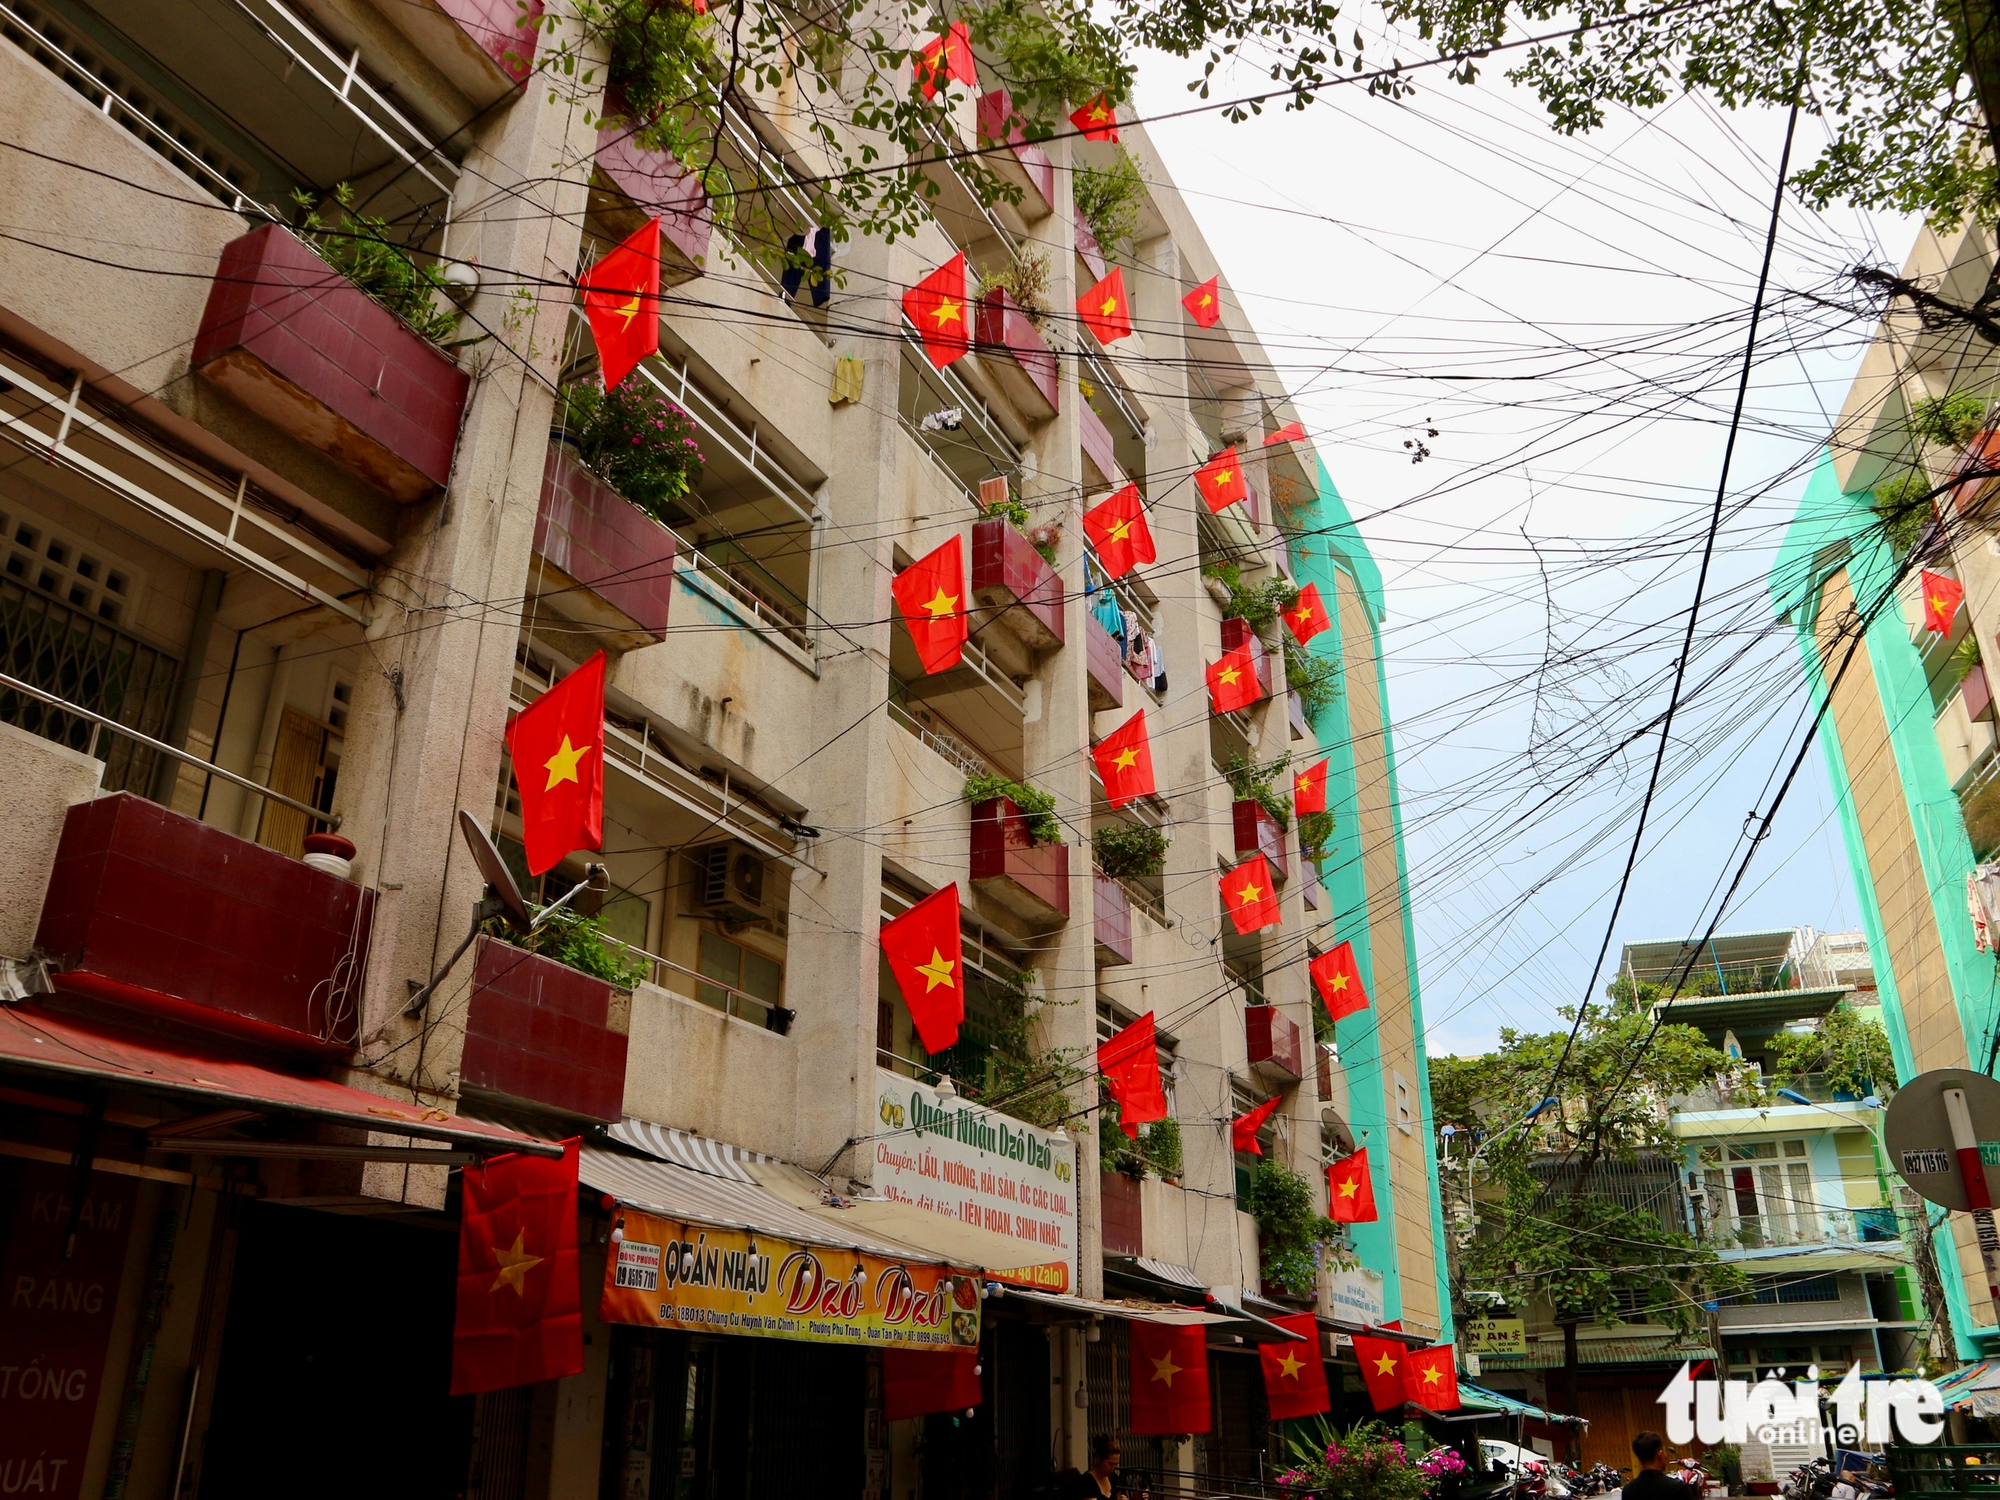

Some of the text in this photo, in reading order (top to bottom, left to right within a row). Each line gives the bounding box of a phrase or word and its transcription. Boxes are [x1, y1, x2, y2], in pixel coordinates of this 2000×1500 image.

[911, 1092, 1051, 1171] Quán Nhậu Dzô Dzô
[877, 1142, 917, 1175] Chuyên:
[919, 1147, 940, 1182] LẨU,
[943, 1160, 978, 1193] NƯỚNG,
[981, 1167, 995, 1195] HẢI
[998, 1172, 1018, 1204] SẢN,
[1020, 1177, 1031, 1206] ỐC
[1033, 1185, 1048, 1210] CÁC
[959, 1198, 982, 1227] LIÊN
[1016, 1215, 1037, 1242] SINH
[12, 1271, 105, 1315] RĂNG
[666, 1234, 949, 1328] QUÁN NHẬU Dzô Dzô
[1034, 1265, 1063, 1289] (Zalo)
[660, 1305, 675, 1320] ĐC:
[707, 1309, 728, 1327] Chung
[730, 1312, 740, 1326] Cư
[741, 1314, 762, 1330] Huỳnh
[764, 1316, 776, 1329] Văn
[795, 1320, 800, 1331] 1
[809, 1321, 830, 1337] Phường
[832, 1322, 844, 1336] Phú
[845, 1324, 861, 1339] Trung
[867, 1326, 881, 1341] Quận
[882, 1328, 893, 1340] Tân
[0, 1353, 87, 1402] TỔNG
[0, 1450, 69, 1493] UÁT
